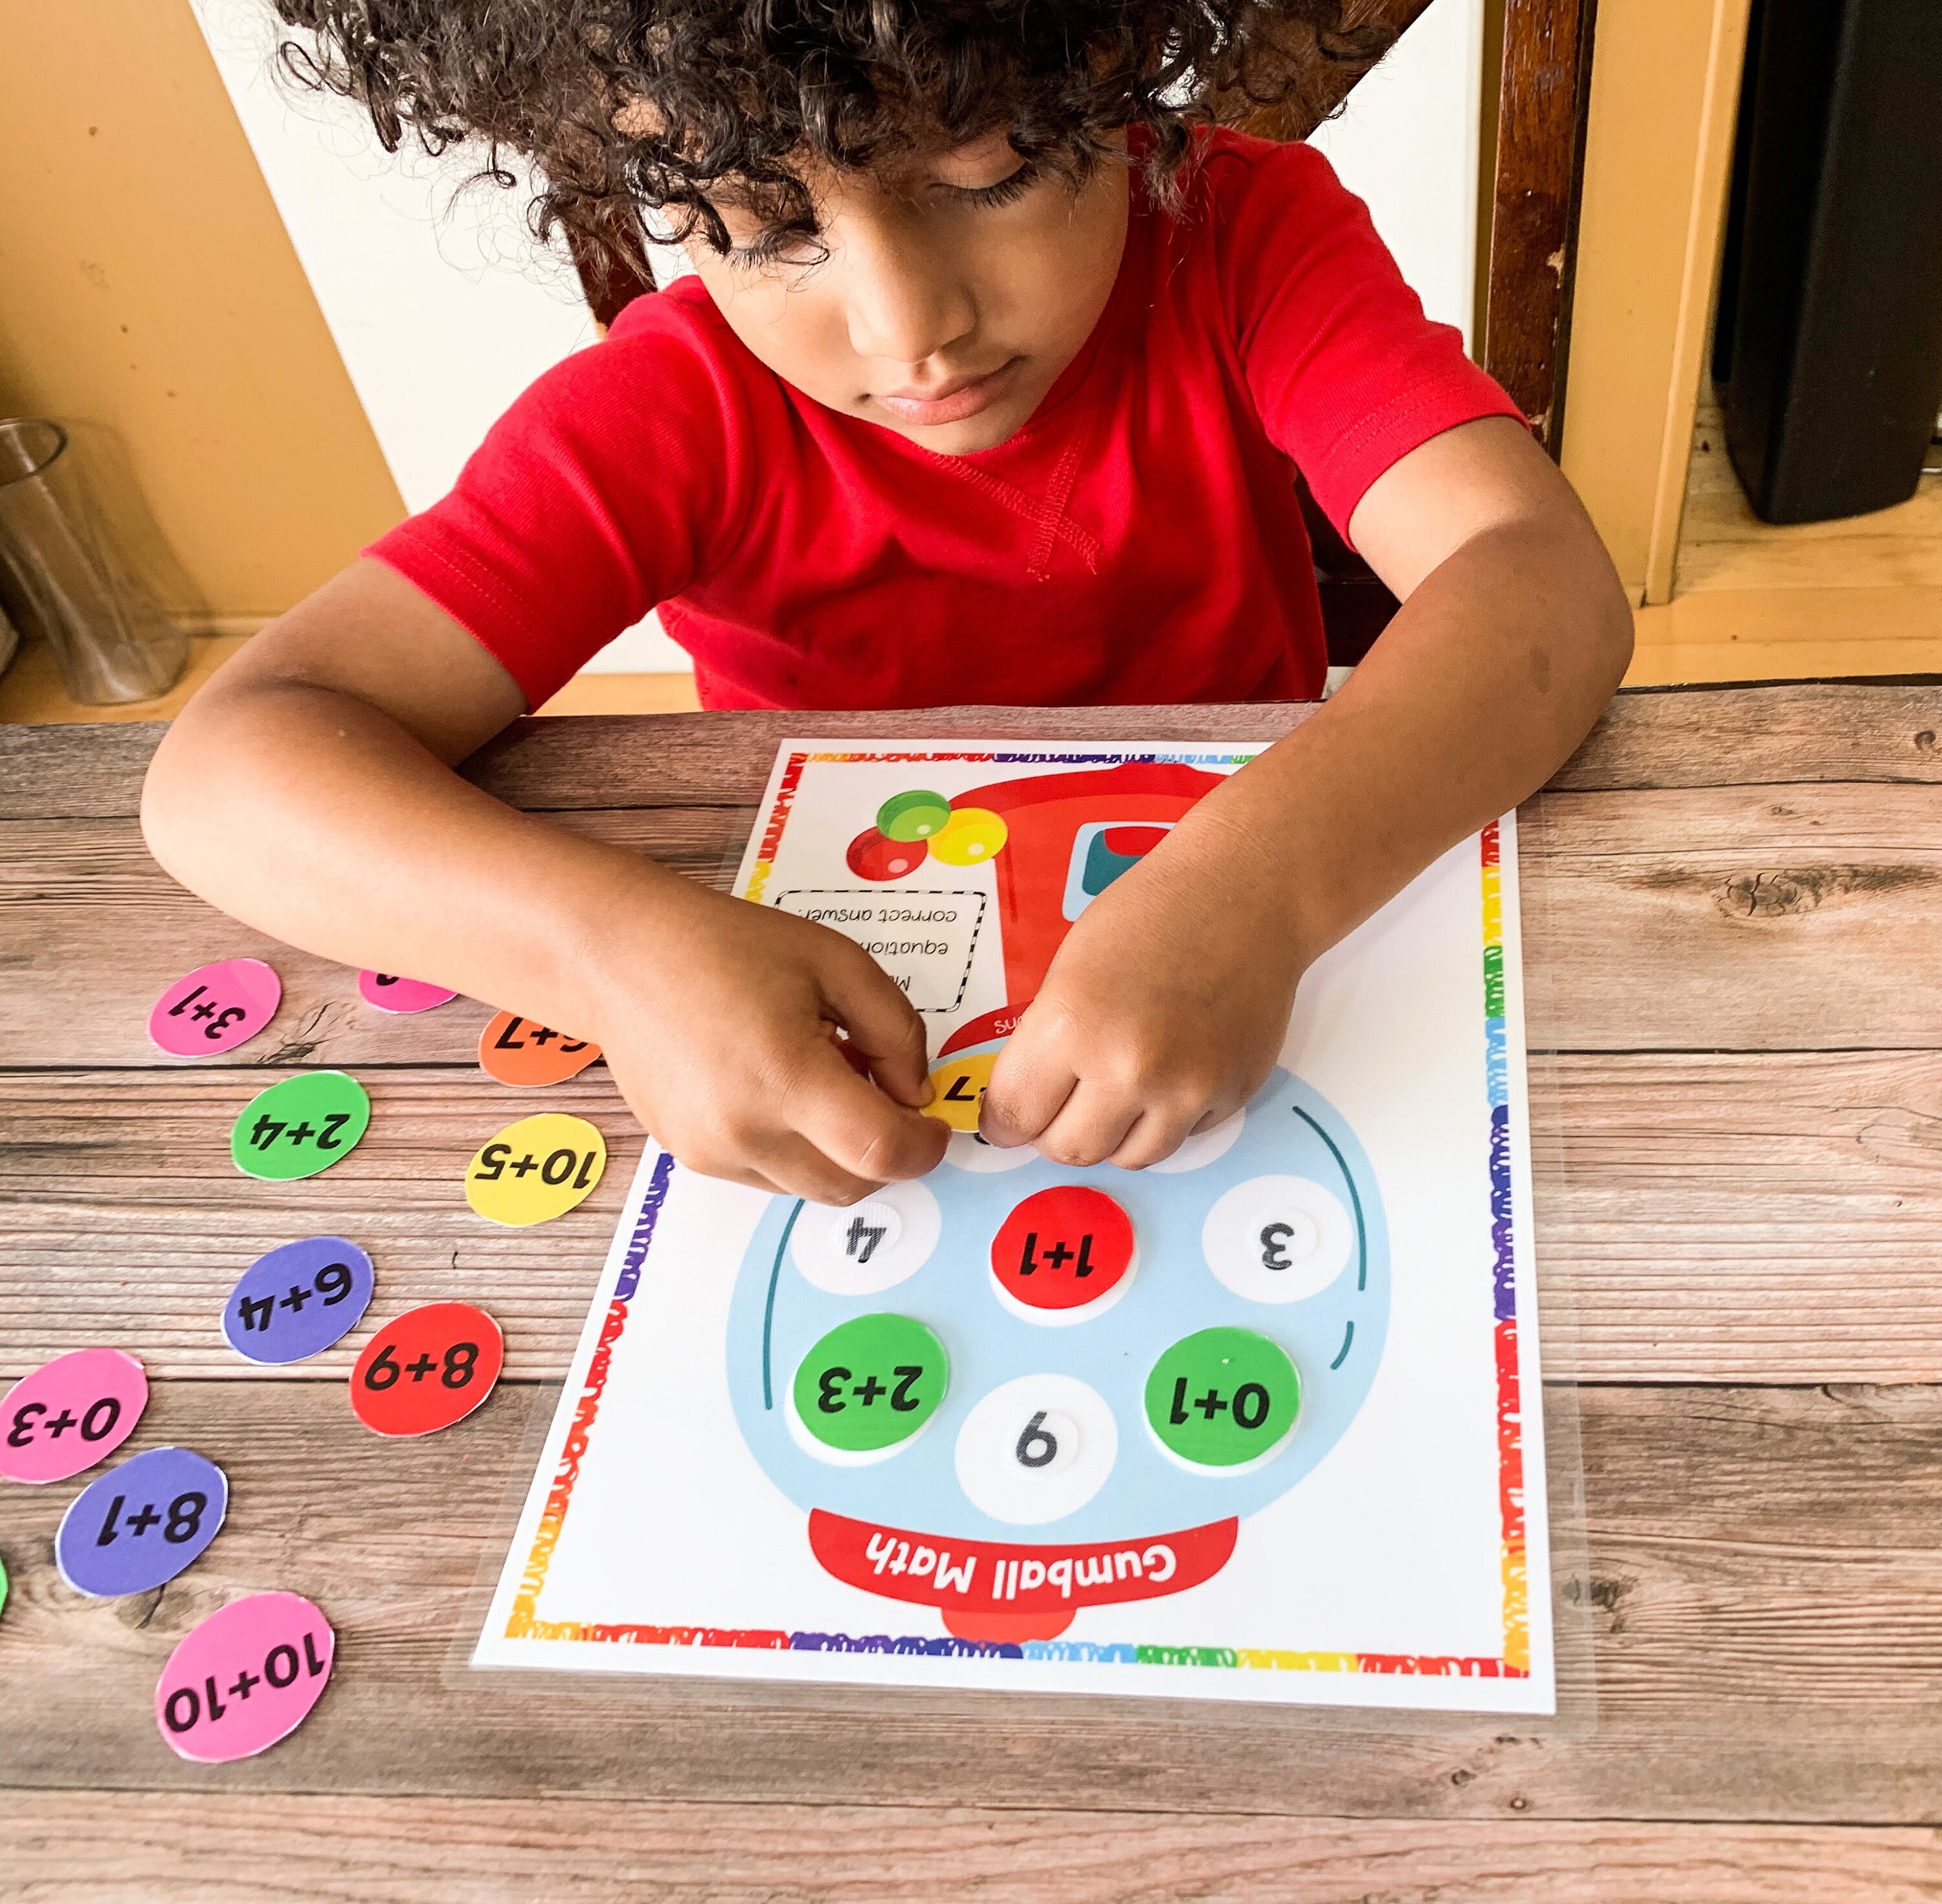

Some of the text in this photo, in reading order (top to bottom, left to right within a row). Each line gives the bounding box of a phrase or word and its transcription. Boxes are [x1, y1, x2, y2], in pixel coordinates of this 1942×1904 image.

[878, 909, 957, 924] correct
[168, 985, 246, 1039] 3+1
[250, 1114, 351, 1151] 2+4
[474, 1143, 597, 1189] 10+5
[845, 1216, 887, 1264] 4
[1019, 1232, 1094, 1278] 1+1
[1259, 1222, 1295, 1271] 3
[238, 1262, 353, 1332] 6+4
[364, 1342, 480, 1391] 8+9
[817, 1365, 924, 1414] 2+3
[6, 1396, 121, 1448] 0+3
[1168, 1376, 1271, 1430] 0+1
[1016, 1411, 1058, 1468] 9
[95, 1491, 208, 1547] 8+1
[865, 1532, 1176, 1600] Gumball Math
[164, 1632, 325, 1734] 10+10
